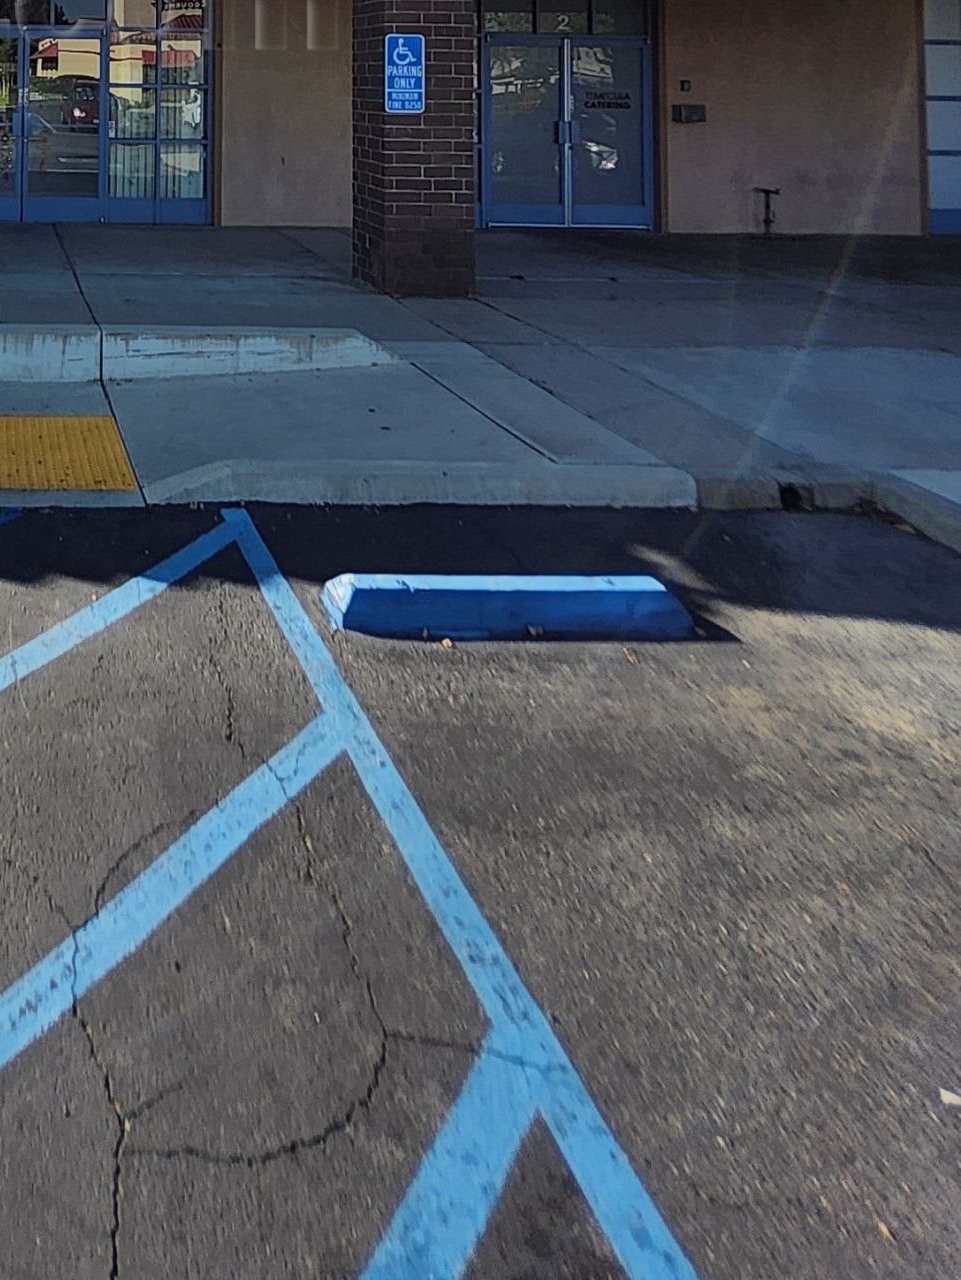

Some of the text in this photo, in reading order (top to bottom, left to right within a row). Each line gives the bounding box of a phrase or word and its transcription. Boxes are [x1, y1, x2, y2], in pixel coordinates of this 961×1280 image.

[557, 14, 570, 31] 2
[387, 65, 422, 77] PARKING
[393, 77, 416, 89] ONLY
[388, 101, 403, 109] FINE
[584, 100, 631, 110] CATERING
